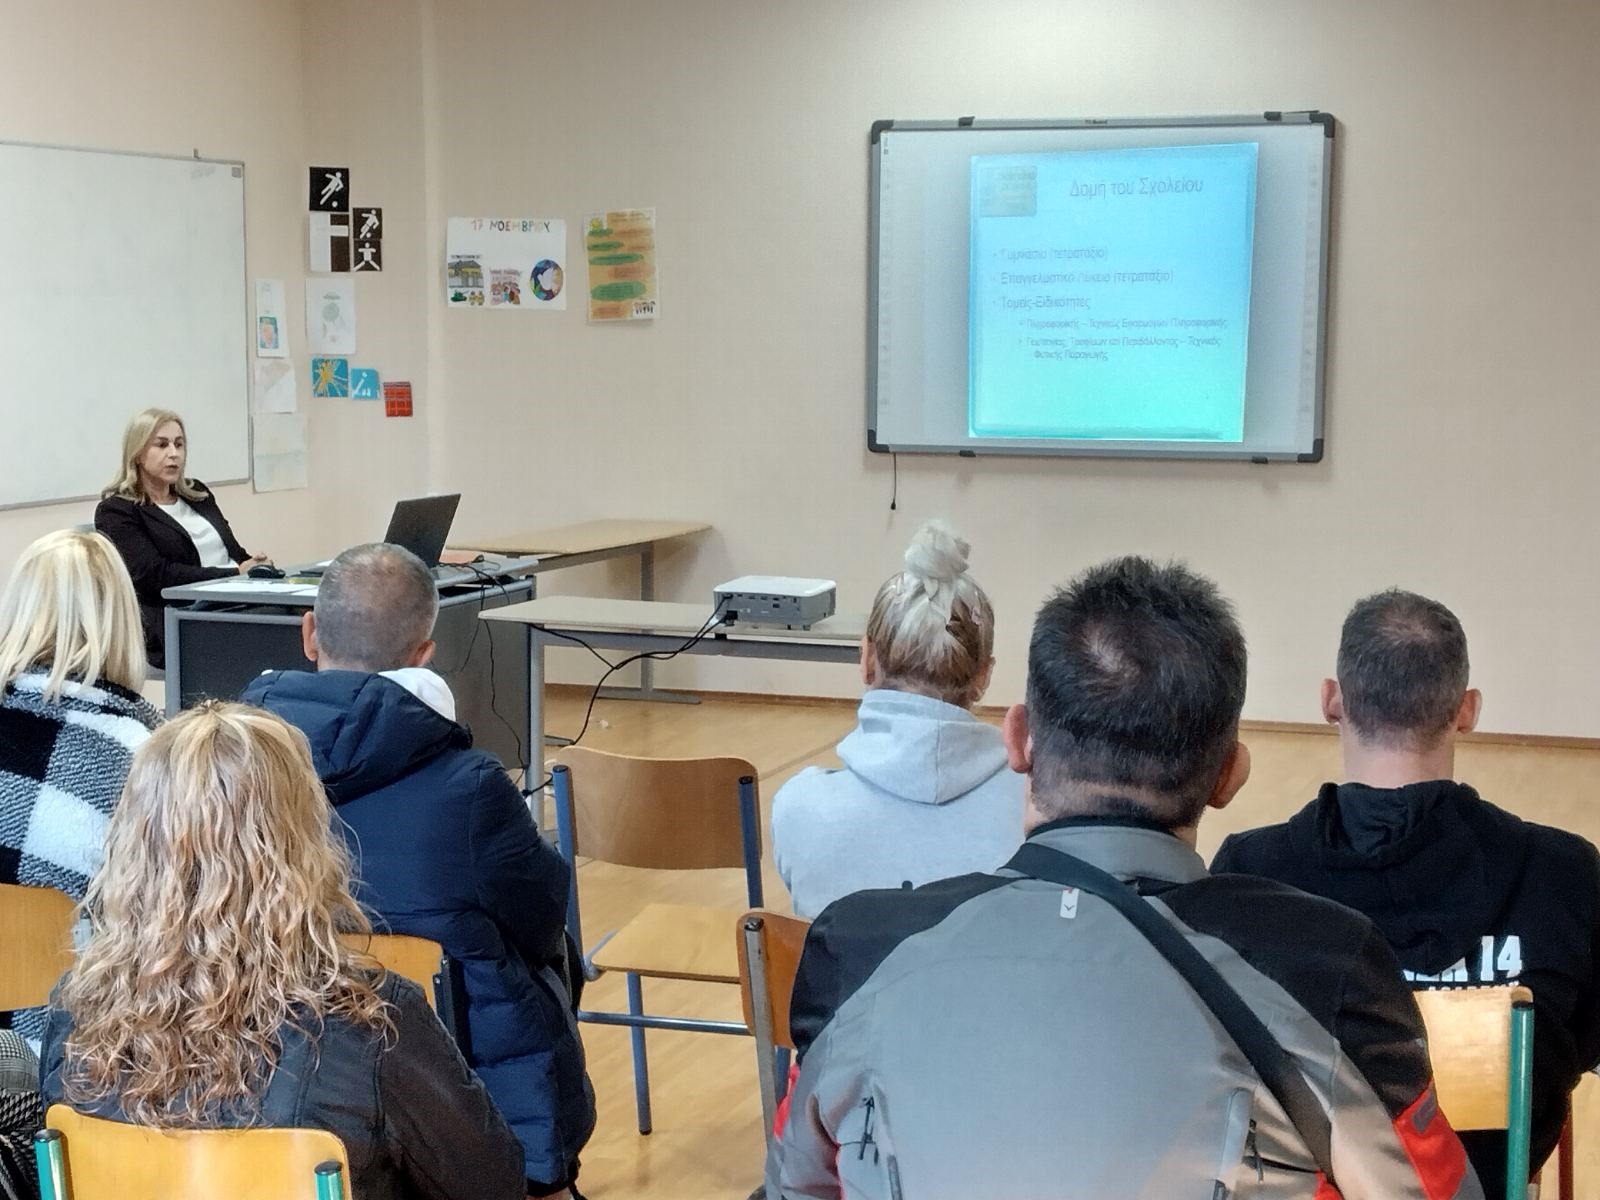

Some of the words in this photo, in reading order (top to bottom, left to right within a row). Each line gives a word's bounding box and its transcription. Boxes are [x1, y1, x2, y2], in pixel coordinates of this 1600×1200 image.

[1110, 182, 1134, 196] του
[1138, 176, 1204, 198] Σχολείου
[1480, 934, 1523, 982] 14
